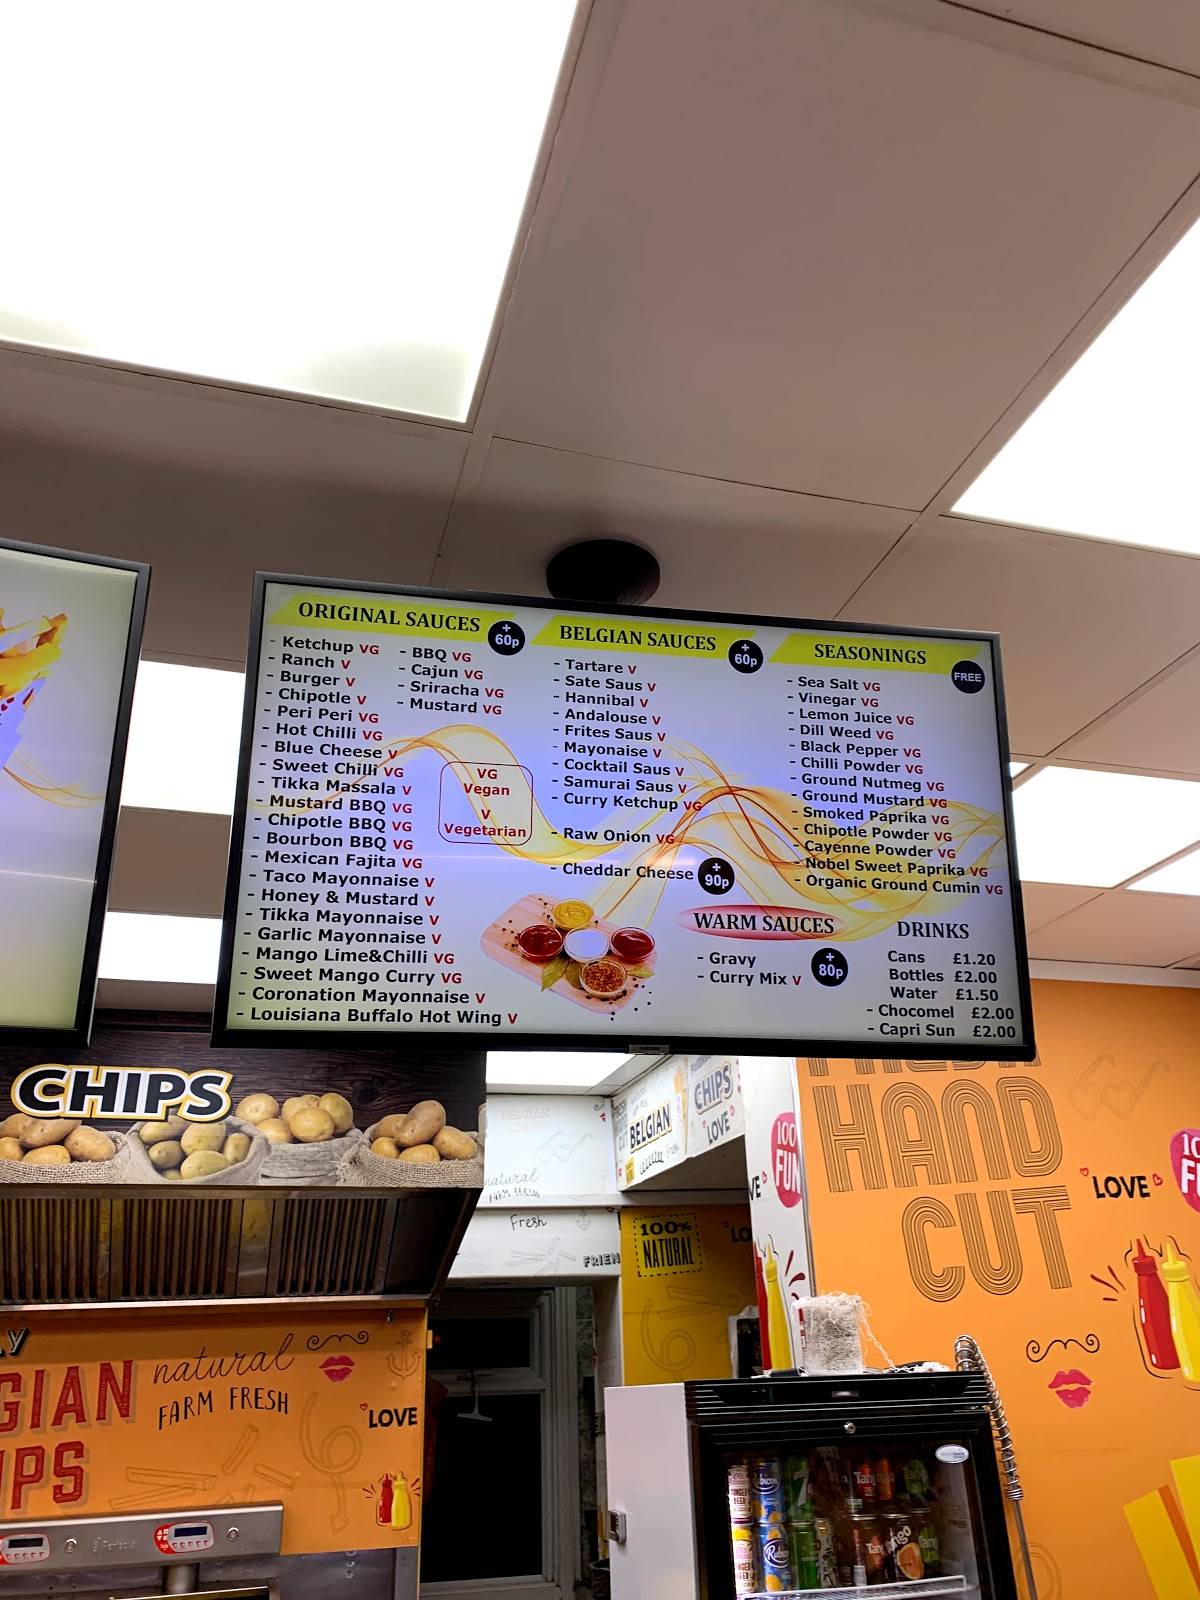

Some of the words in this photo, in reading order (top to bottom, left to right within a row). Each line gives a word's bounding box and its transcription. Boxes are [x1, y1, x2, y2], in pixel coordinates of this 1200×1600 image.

[299, 602, 400, 625] ORIGINAL
[406, 612, 480, 632] SAUCES
[283, 636, 354, 655] Ketchup
[495, 633, 519, 648] 60p
[560, 625, 642, 645] BELGIAN
[648, 632, 716, 651] SAUCES
[282, 653, 334, 668] Ranch
[413, 647, 447, 663] BBQ
[452, 652, 471, 662] VG
[735, 653, 758, 667] 60p
[815, 644, 926, 664] SEASONINGS
[411, 664, 458, 679] Cajun
[464, 670, 483, 680] VG
[565, 659, 623, 673] Tartare
[280, 670, 340, 687] Burger
[565, 675, 600, 688] Sate
[606, 678, 642, 691] Saus
[798, 676, 824, 688] Sea
[830, 678, 858, 690] Salt
[954, 672, 982, 682] FREE
[279, 688, 351, 704] Chipotle
[410, 681, 479, 696] Sriracha
[485, 688, 504, 698] VG
[410, 698, 477, 713] Mustard
[483, 705, 502, 715] VG
[566, 692, 634, 707] Hannibal
[798, 692, 856, 707] Vinegar
[278, 705, 311, 718] Peri
[319, 708, 352, 721] Peri
[565, 709, 647, 724] Andalouse
[800, 708, 849, 721] Lemon
[854, 712, 892, 724] Juice
[276, 723, 307, 736] Hot
[313, 725, 356, 739] Chilli
[566, 725, 610, 738] Frites
[615, 728, 652, 741] Saus
[800, 724, 824, 736] Dill
[829, 726, 871, 739] Weed
[275, 741, 313, 754] Blue
[320, 744, 382, 758] Cheese
[565, 742, 648, 757] Mayonaise
[801, 741, 841, 753] Black
[846, 743, 899, 758] Pepper
[273, 759, 328, 773] Sweet
[334, 762, 377, 776] Chilli
[477, 768, 497, 779] VG
[565, 759, 627, 773] Cocktail
[633, 763, 670, 775] Saus
[801, 757, 838, 769] Chilli
[844, 760, 901, 773] Powder
[271, 776, 319, 790] Tikka
[326, 780, 395, 794] Massala
[464, 783, 509, 797] Vegan
[564, 775, 630, 790] Samurai
[636, 780, 673, 793] Saus
[802, 773, 857, 787] Ground
[863, 777, 921, 793] Nutmeg
[270, 795, 342, 810] Mustard
[350, 799, 386, 815] BBQ
[564, 793, 608, 809] Curry
[614, 795, 678, 812] Ketchup
[802, 790, 858, 803] Ground
[864, 793, 924, 807] Mustard
[481, 809, 490, 819] V
[803, 807, 864, 820] Smoked
[870, 810, 926, 824] Paprika
[268, 813, 342, 829] Chipotle
[349, 817, 386, 833] BBQ
[444, 823, 526, 837] Vegetarian
[804, 823, 867, 838] Chipotle
[872, 827, 929, 840] Powder
[267, 832, 343, 847] Bourbon
[350, 836, 387, 852] BBQ
[564, 827, 598, 840] Raw
[604, 830, 650, 843] Onion
[805, 840, 870, 857] Cayenne
[875, 844, 933, 857] Powder
[265, 850, 339, 865] Mexican
[346, 854, 396, 869] Fajita
[805, 857, 849, 870] Nobel
[855, 860, 903, 873] Sweet
[908, 862, 965, 877] Paprika
[263, 869, 306, 883] Taco
[313, 871, 419, 887] Mayonnaise
[563, 863, 631, 877] Cheddar
[637, 865, 693, 879] Cheese
[704, 874, 729, 888] 90p
[806, 875, 867, 889] Organic
[871, 878, 927, 891] Ground
[932, 881, 980, 894] Cumin
[262, 889, 320, 905] Honey
[326, 891, 339, 903] &
[346, 892, 418, 906] Mustard
[260, 908, 309, 922] Tikka
[317, 910, 423, 926] Mayonnaise
[694, 912, 758, 930] WARM
[762, 915, 834, 933] SAUCES
[258, 927, 312, 941] Garlic
[318, 929, 425, 945] Mayonnaise
[897, 921, 969, 939] DRINKS
[256, 947, 318, 963] Mango
[325, 949, 427, 963] Lime&Chilli
[710, 952, 756, 968] Gravy
[888, 950, 925, 963] Cans
[953, 953, 996, 966] £1.20
[254, 967, 312, 981] Sweet
[319, 968, 379, 985] Mango
[386, 970, 435, 986] Curry
[710, 971, 754, 987] Curry
[760, 973, 787, 985] Mix
[818, 963, 844, 979] 80p
[889, 969, 944, 982] Bottles
[954, 971, 997, 983] £2.00
[252, 987, 355, 1001] Coronation
[363, 989, 469, 1005] Mayonnaise
[890, 986, 938, 999] Water
[956, 988, 999, 1001] £1.50
[251, 1007, 340, 1022] Louisiana
[348, 1009, 413, 1022] Buffalo
[420, 1010, 451, 1023] Hot
[457, 1011, 501, 1027] Wing
[879, 1004, 954, 1018] Chocomel
[972, 1007, 1014, 1020] £2.00
[880, 1023, 920, 1038] Capri
[926, 1024, 955, 1037] Sun
[973, 1025, 1016, 1038] £2.00
[13, 1065, 231, 1121] CHIPS
[694, 1065, 733, 1112] CHIPS
[629, 1104, 671, 1149] BELGIAN
[707, 1111, 730, 1145] LOVE
[812, 1076, 1063, 1193] HAND
[775, 1148, 800, 1194] FUN
[1092, 1175, 1151, 1199] LOVE
[510, 1213, 548, 1230] Fresh
[640, 1221, 692, 1236] 100%
[902, 1185, 1072, 1302] CUT
[643, 1236, 695, 1269] NATURAL
[153, 1332, 295, 1384] natural
[158, 1390, 213, 1430] FARM
[230, 1386, 289, 1415] FRESH
[368, 1407, 418, 1429] LOVE
